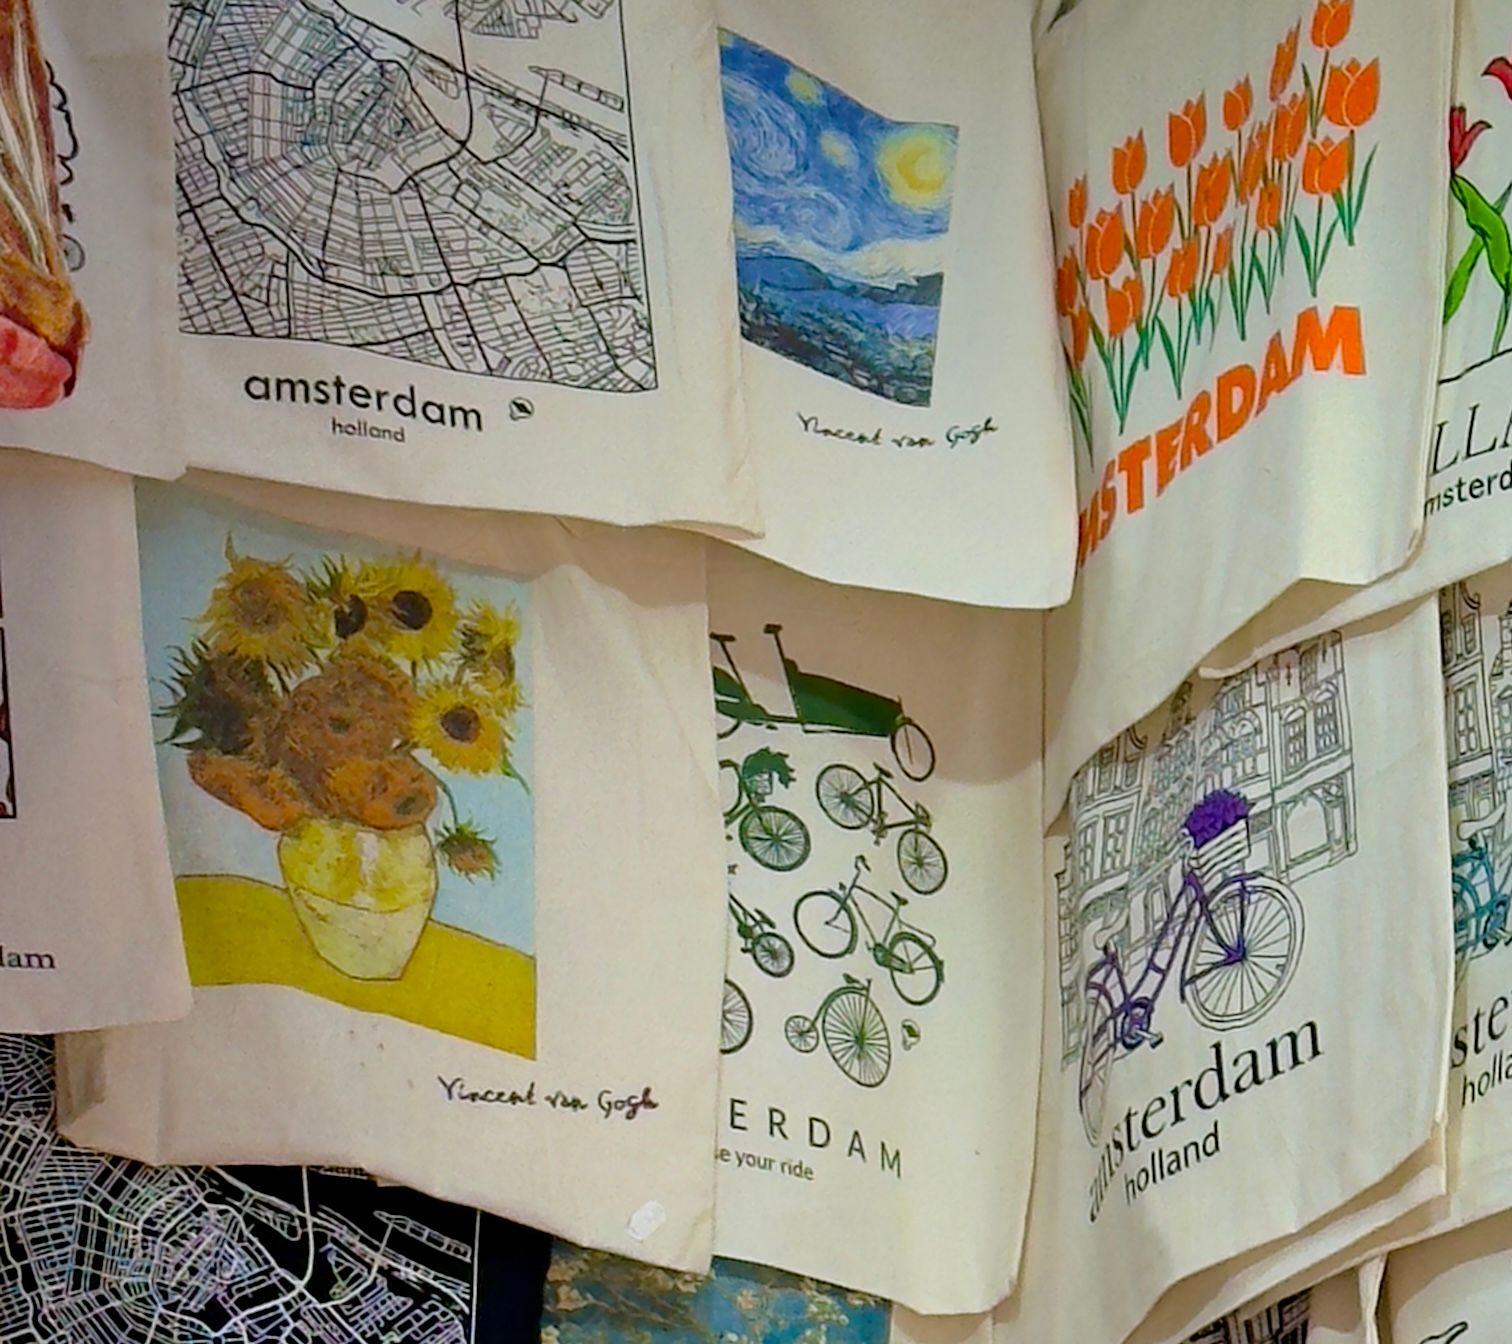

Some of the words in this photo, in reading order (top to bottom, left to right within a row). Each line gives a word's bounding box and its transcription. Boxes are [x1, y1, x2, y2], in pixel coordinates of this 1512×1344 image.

[244, 368, 484, 431] amsterdam
[331, 417, 406, 443] holland
[1077, 306, 1367, 566] MSTERDAM
[437, 1076, 536, 1106] Vincent
[544, 1090, 588, 1111] van
[597, 1089, 659, 1119] Gogh
[729, 1098, 903, 1179] ERDAM
[735, 1152, 775, 1172] your
[780, 1157, 814, 1180] ride
[1124, 1122, 1220, 1206] holland
